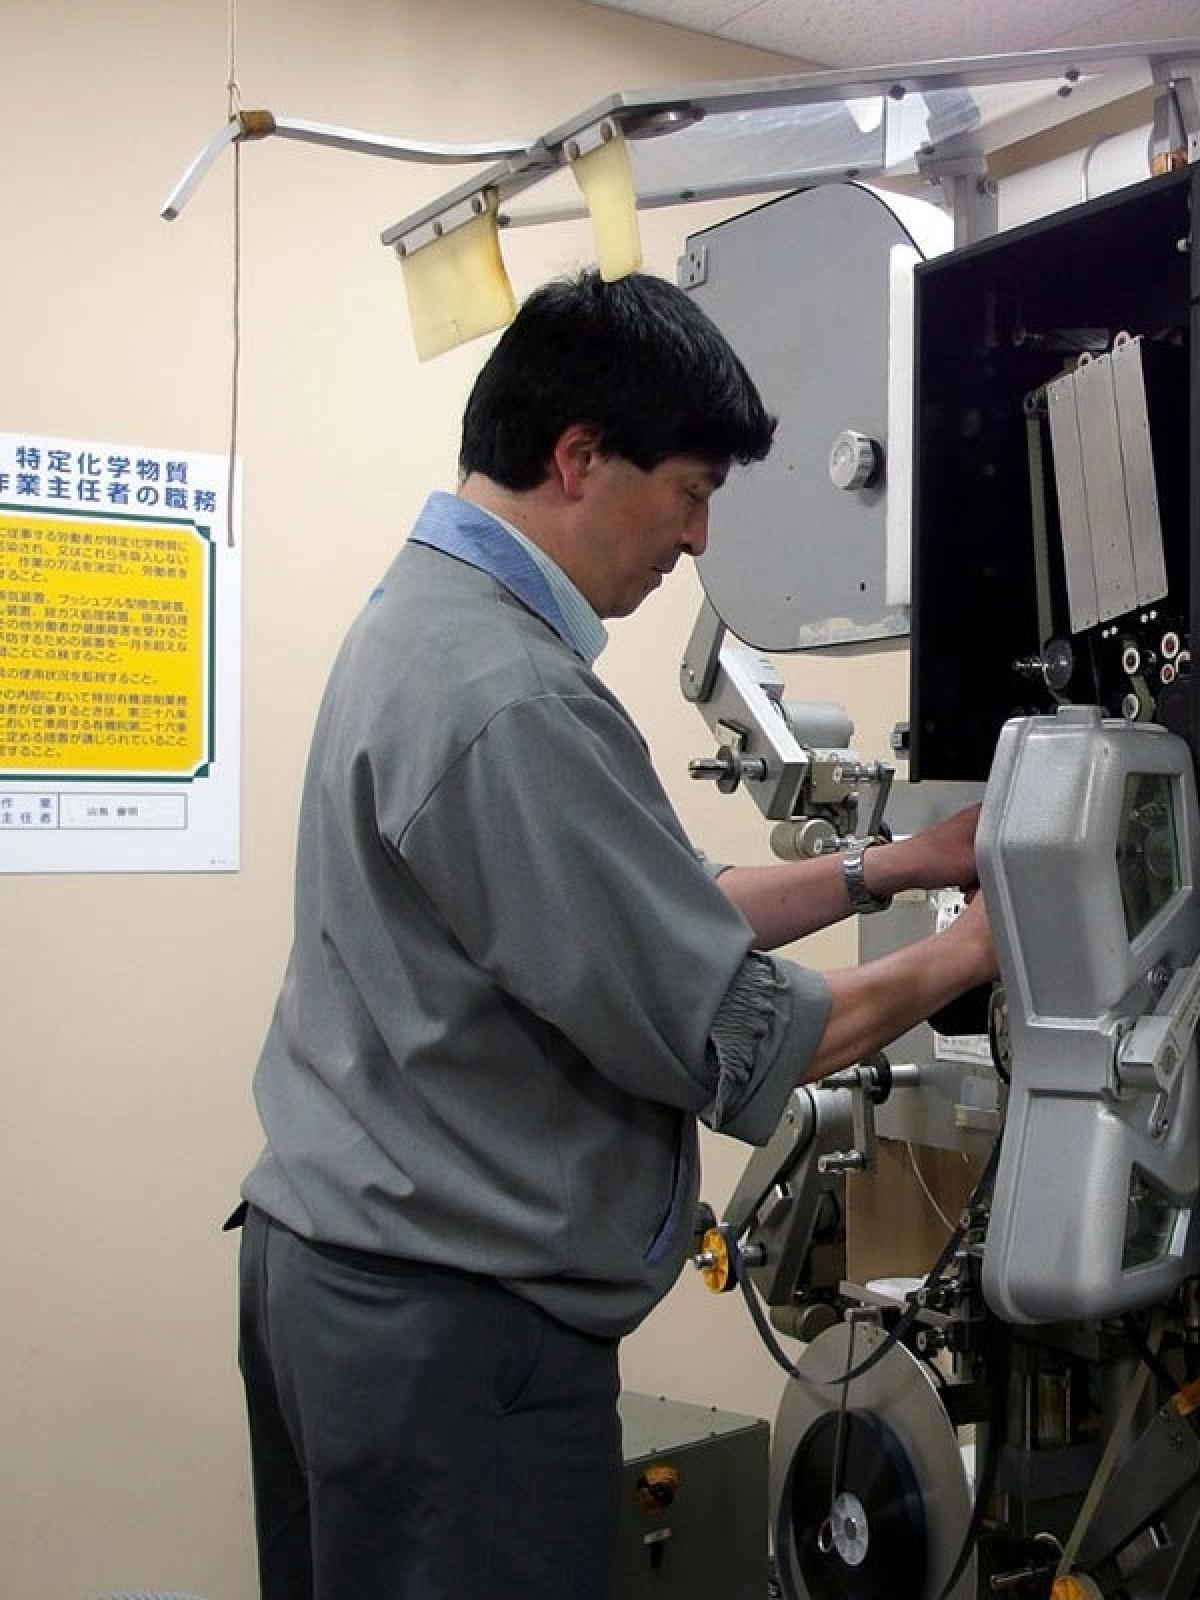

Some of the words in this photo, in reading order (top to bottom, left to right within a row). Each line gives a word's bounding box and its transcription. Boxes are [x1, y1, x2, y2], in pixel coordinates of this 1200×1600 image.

[16, 445, 188, 485] 特定化学物質
